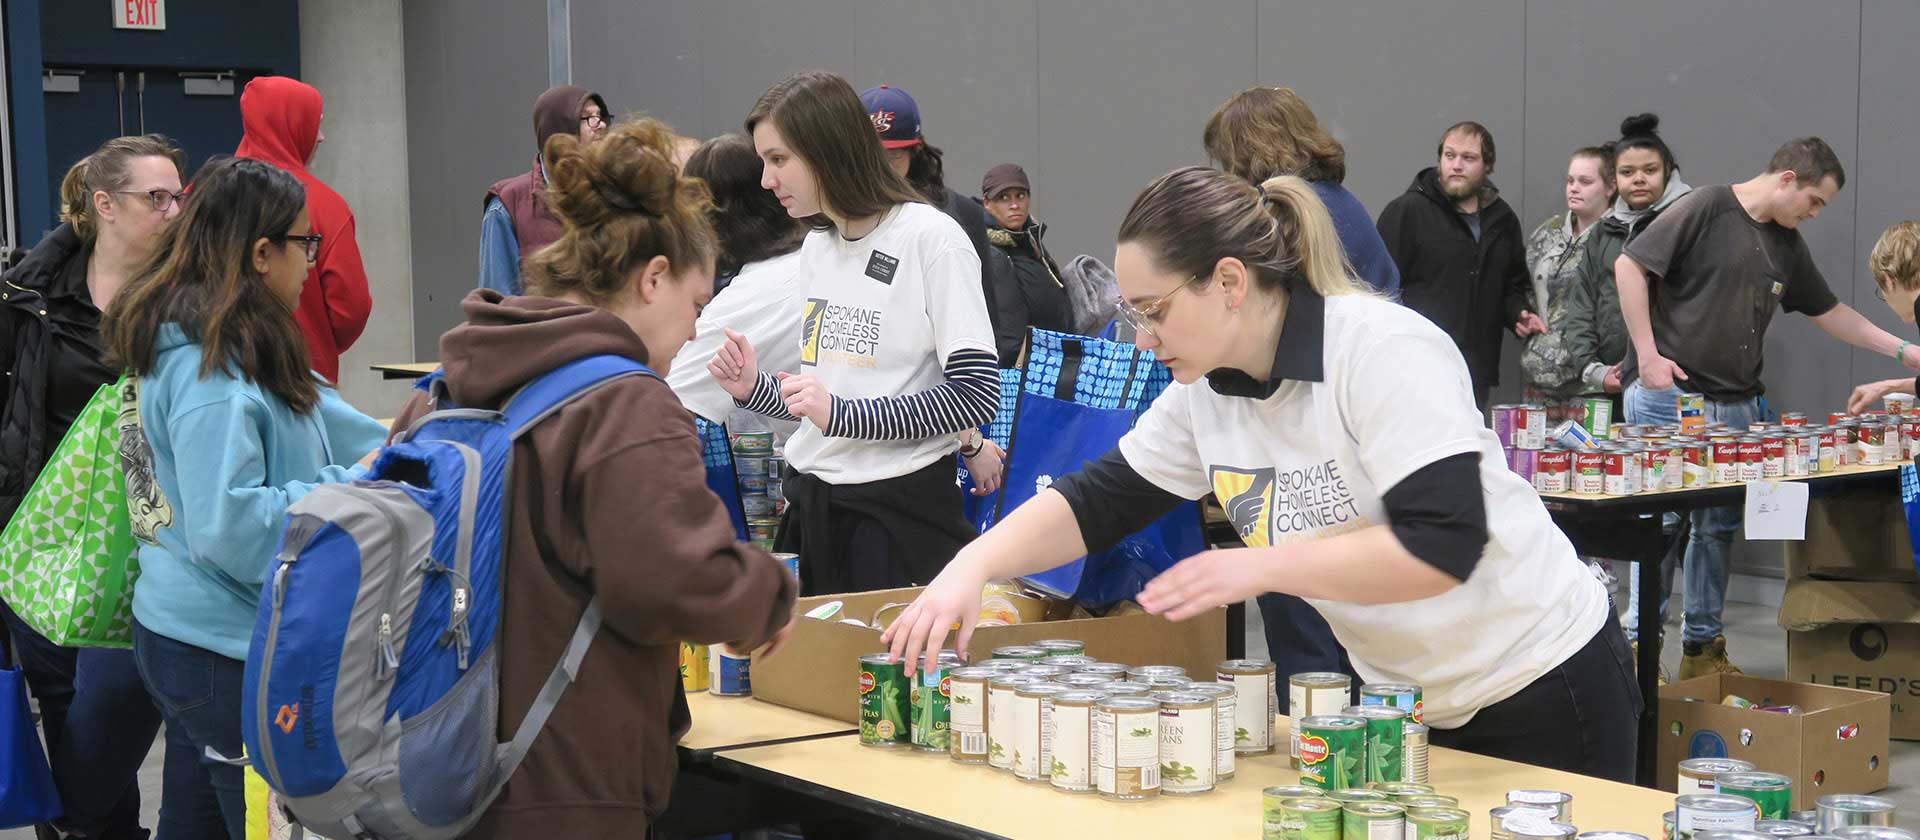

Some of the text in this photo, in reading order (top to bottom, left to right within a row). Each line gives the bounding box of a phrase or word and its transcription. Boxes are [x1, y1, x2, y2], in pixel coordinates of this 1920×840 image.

[125, 0, 157, 26] EXIT
[825, 305, 882, 327] SPOKANE
[822, 321, 880, 341] HOMELESS
[820, 334, 879, 356] CONNECT
[1278, 480, 1350, 512] HOMELESS
[1276, 497, 1360, 533] CONNECT
[1160, 726, 1184, 736] REEN
